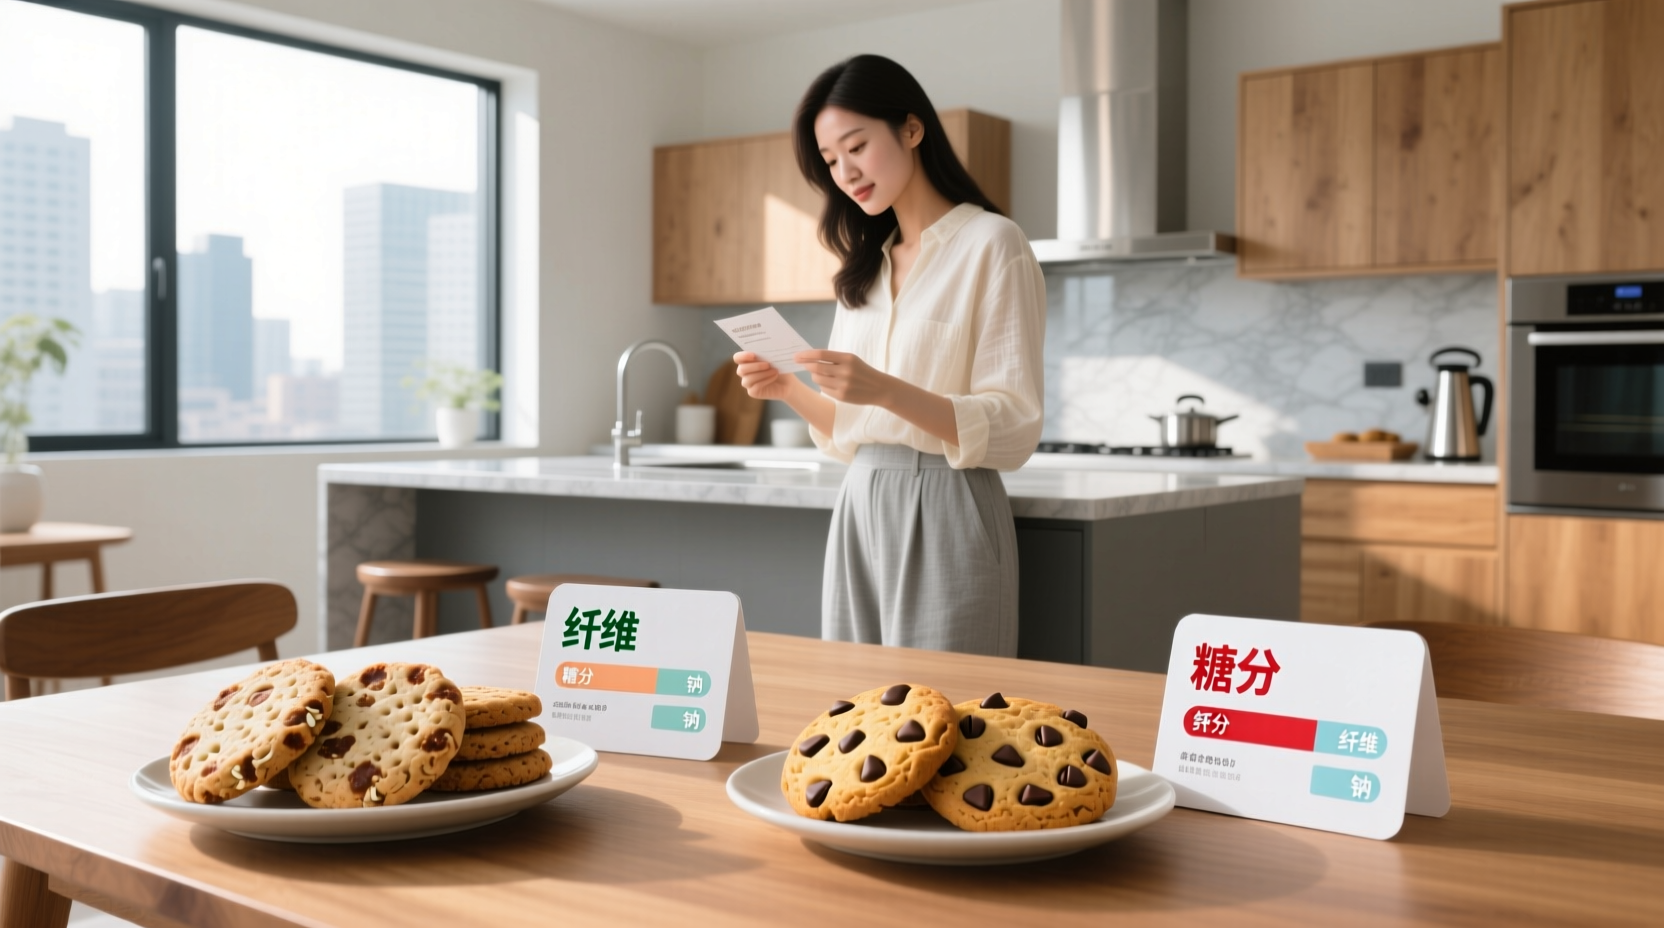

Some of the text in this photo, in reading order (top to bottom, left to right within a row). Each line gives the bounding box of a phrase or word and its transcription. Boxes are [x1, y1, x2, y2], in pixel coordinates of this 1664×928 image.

[562, 606, 639, 652] 纤维
[1190, 643, 1281, 695] 糖分
[1338, 729, 1378, 754] 纤维
[1351, 774, 1372, 799] 钠
